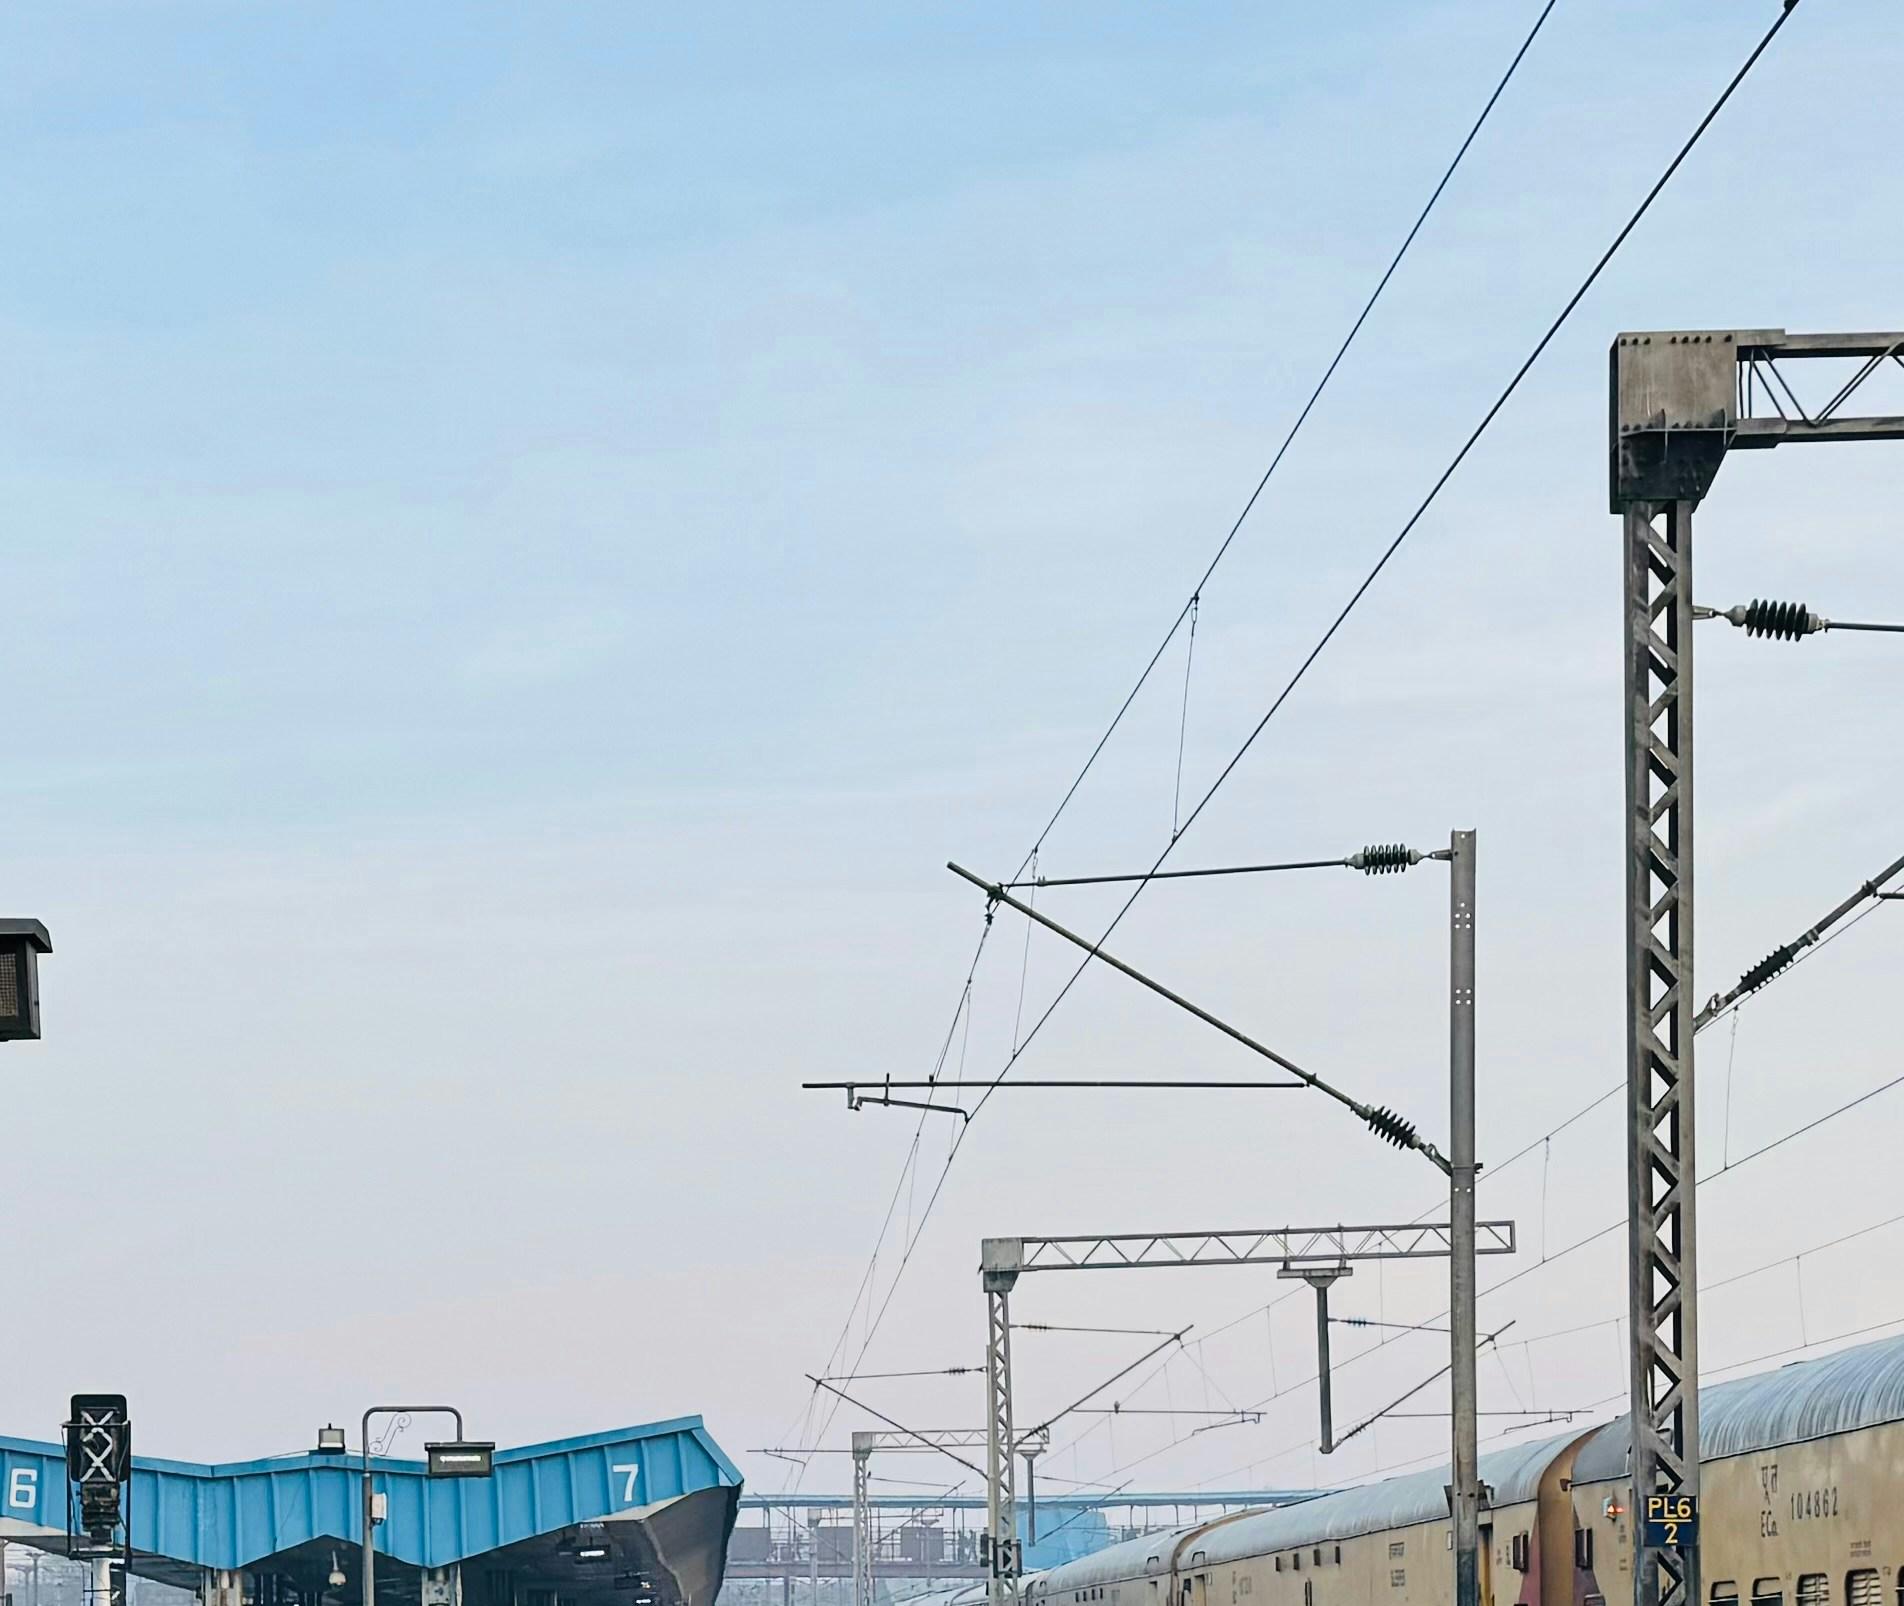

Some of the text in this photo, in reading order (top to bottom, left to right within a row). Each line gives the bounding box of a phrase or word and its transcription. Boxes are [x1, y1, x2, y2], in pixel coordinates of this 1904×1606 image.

[9, 1468, 38, 1509] 6
[612, 1463, 639, 1502] 7
[1648, 1497, 1692, 1518] PL-6
[1791, 1486, 1839, 1520] 104862
[1664, 1522, 1679, 1544] 2
